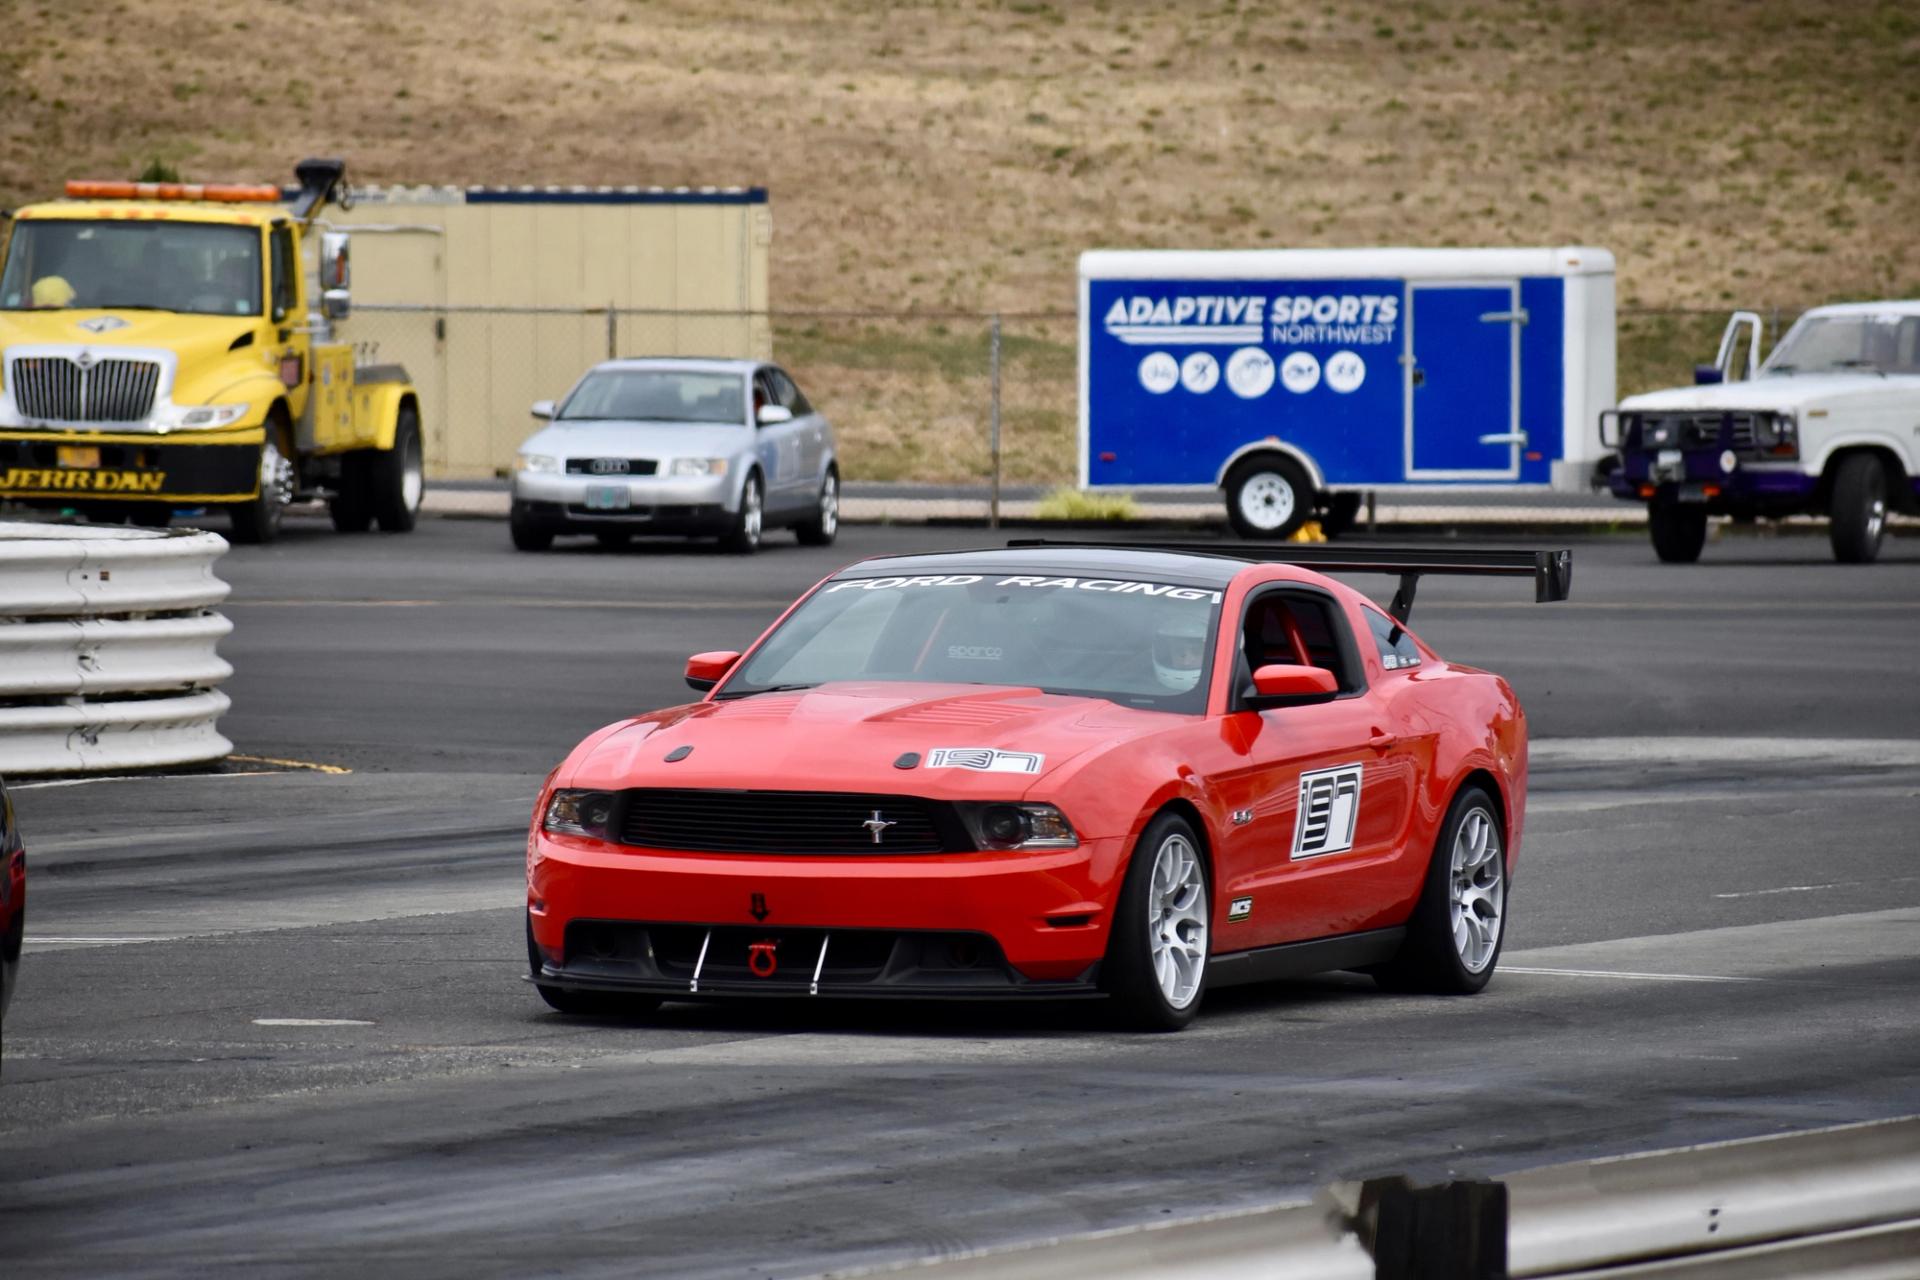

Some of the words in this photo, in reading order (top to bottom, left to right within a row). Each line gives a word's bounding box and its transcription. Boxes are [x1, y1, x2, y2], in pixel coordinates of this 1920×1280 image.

[1104, 296, 1265, 324] ADAPTIVE
[1270, 295, 1398, 324] SPORTS
[1271, 324, 1395, 344] NORTHWEST
[826, 575, 983, 593] FORD
[996, 576, 1214, 600] RACING
[933, 750, 1038, 772] 197
[1294, 773, 1358, 853] 197
